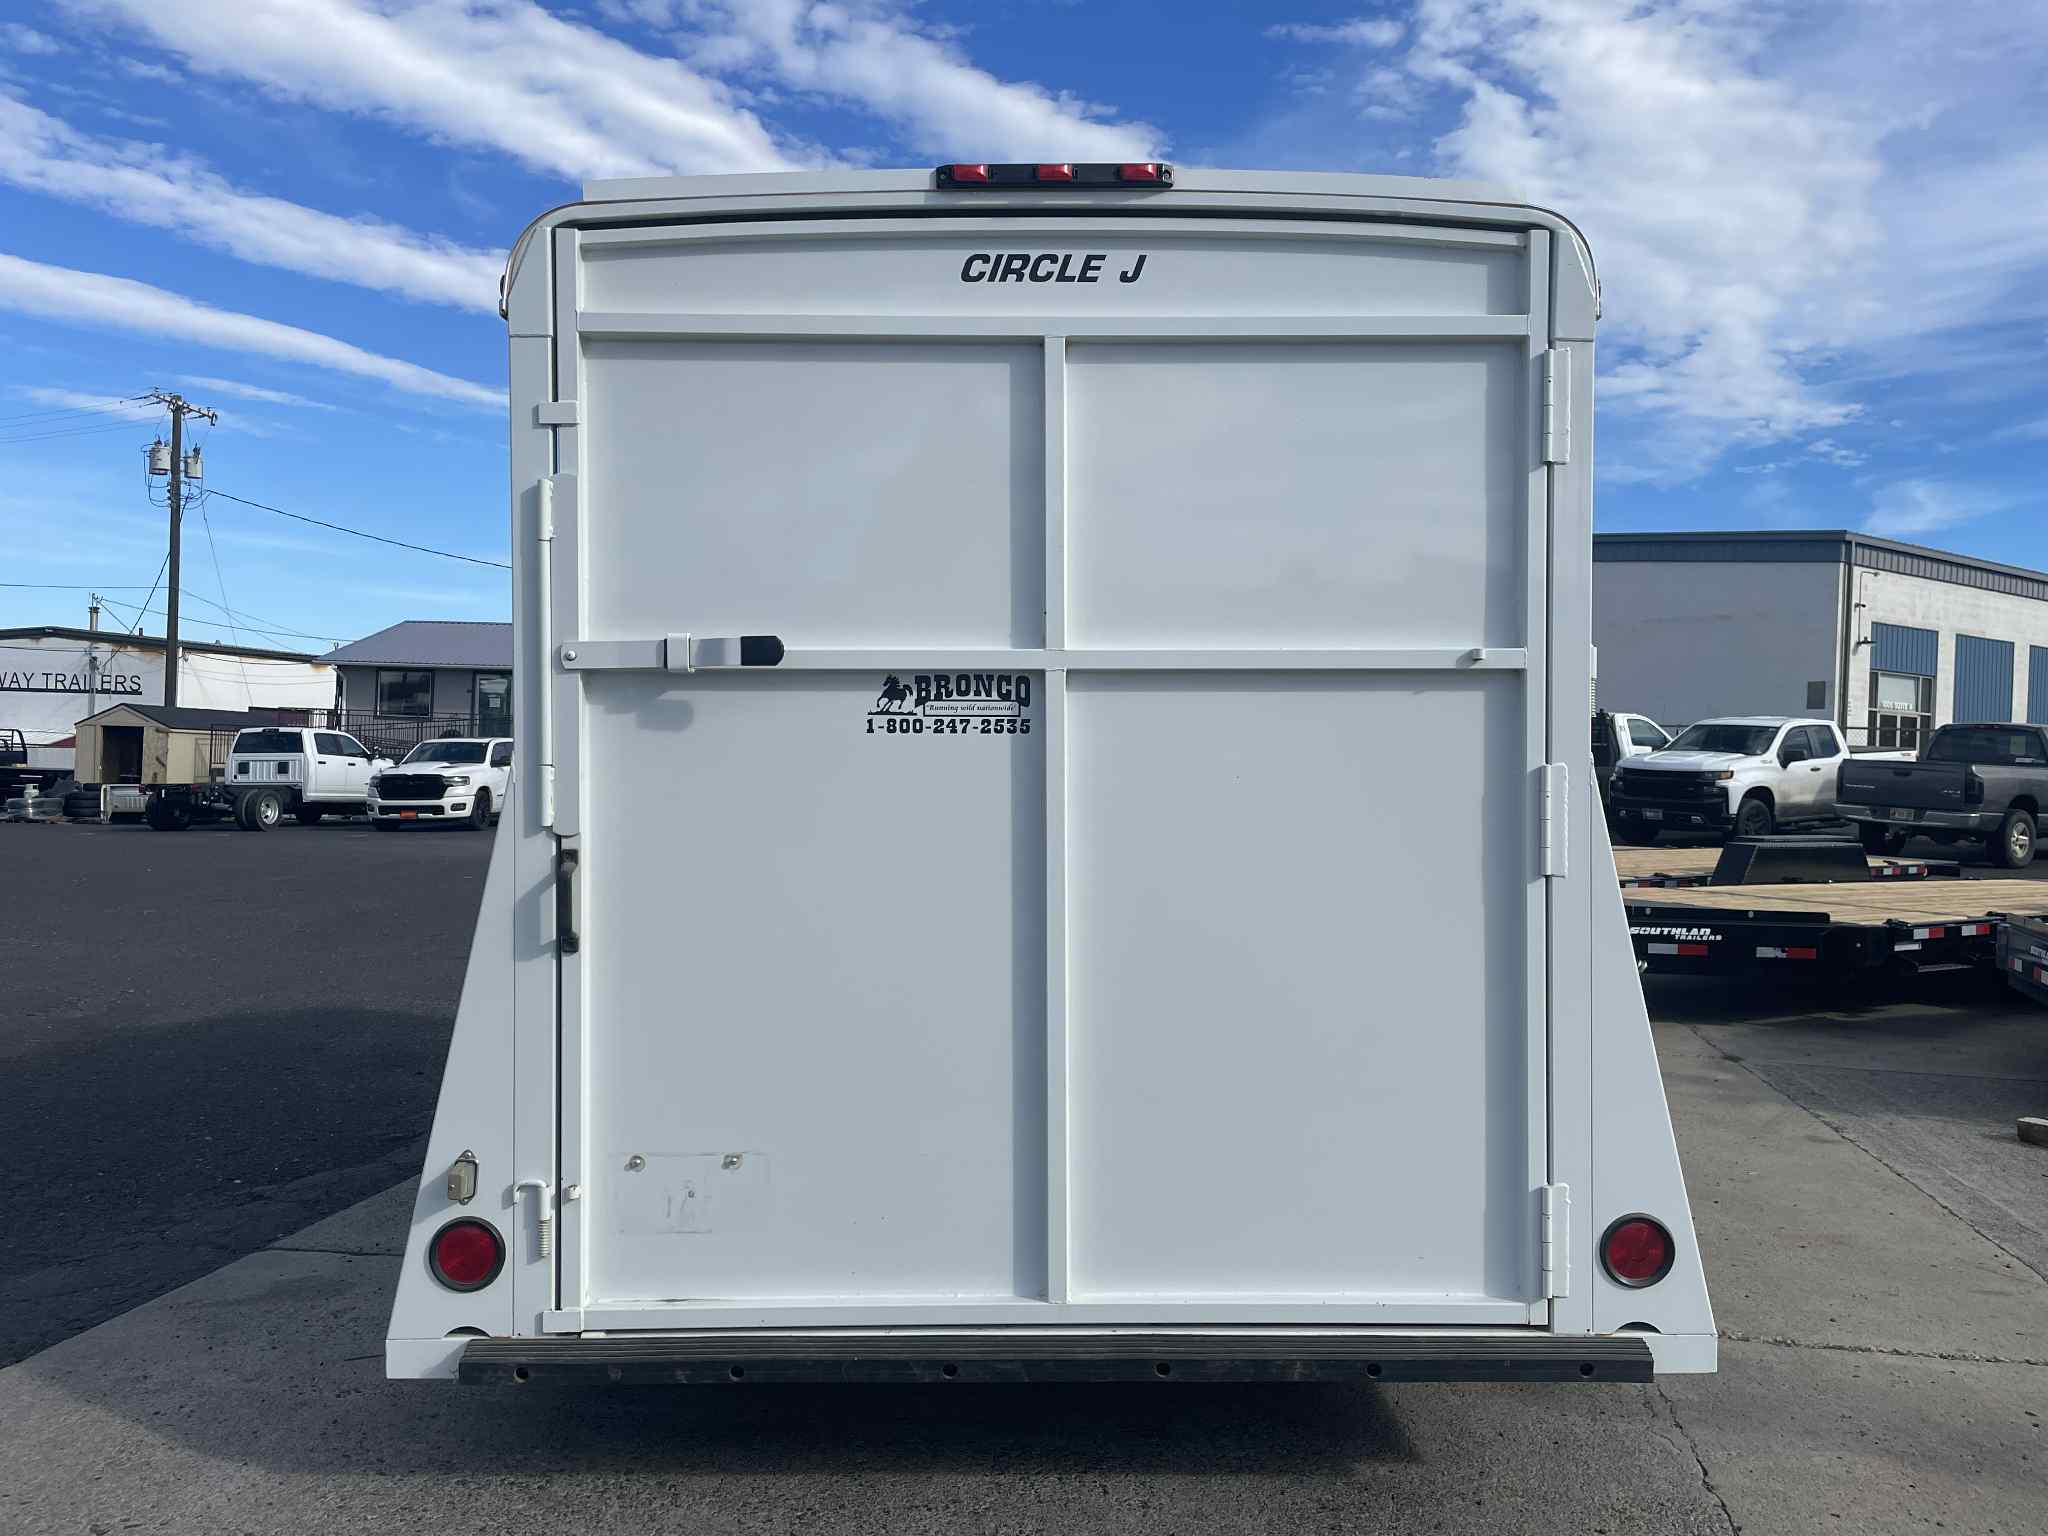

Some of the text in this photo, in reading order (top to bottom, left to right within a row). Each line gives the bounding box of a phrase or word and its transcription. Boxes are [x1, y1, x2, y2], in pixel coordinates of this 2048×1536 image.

[960, 254, 1148, 283] CIRCLE J
[915, 674, 1031, 707] BRONCO
[866, 718, 1031, 735] 1-800-247-2535
